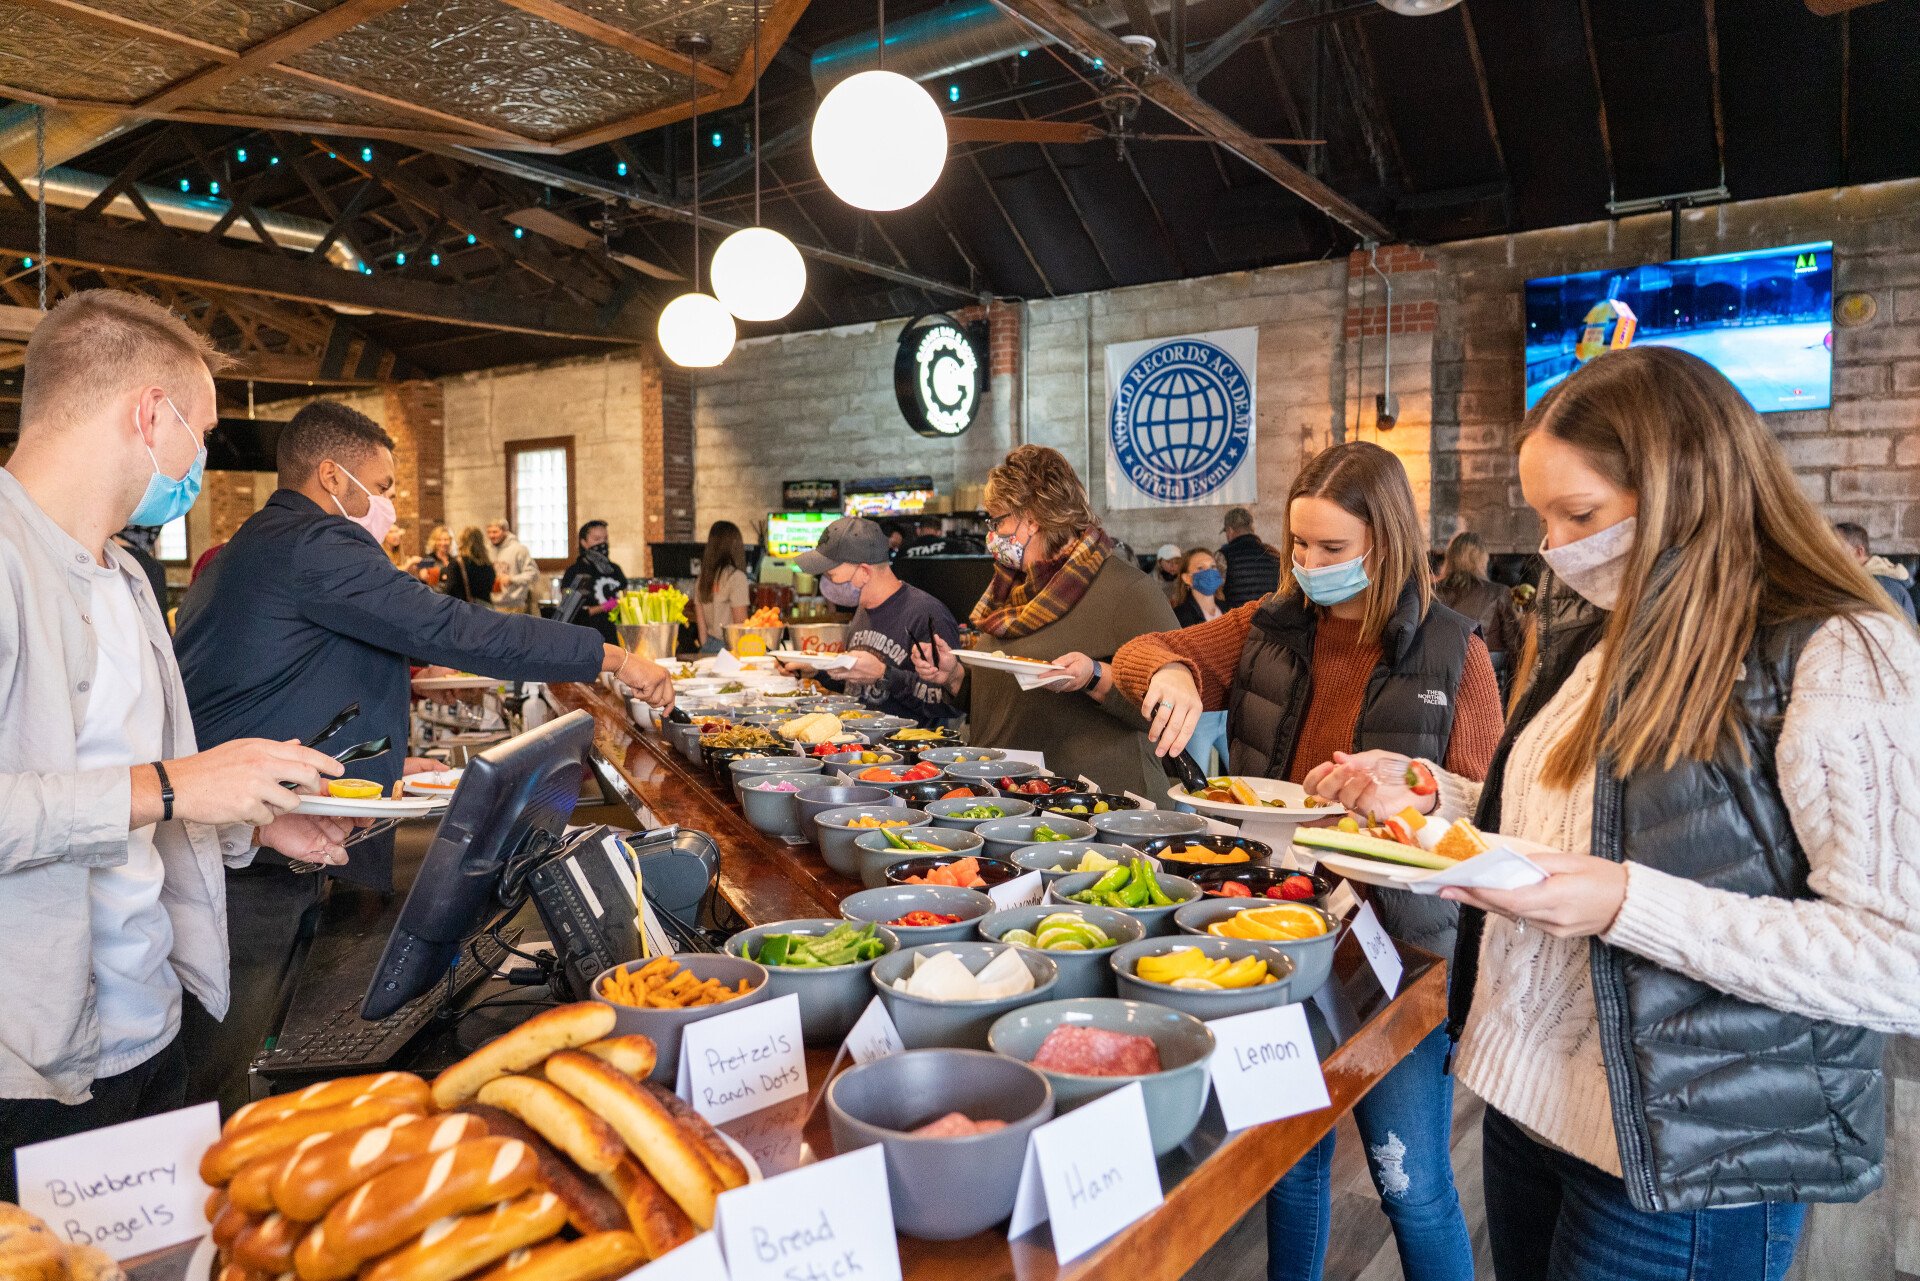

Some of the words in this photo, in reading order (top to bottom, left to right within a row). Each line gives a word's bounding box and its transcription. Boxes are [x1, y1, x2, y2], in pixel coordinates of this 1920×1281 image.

[1114, 383, 1135, 453] WORLD
[1130, 345, 1210, 384] RECORDS
[1208, 356, 1250, 444] ACADEMY
[1131, 465, 1185, 497] Official
[1190, 459, 1233, 492] Event
[907, 542, 946, 558] STAFF
[705, 1035, 792, 1076] Pretzels
[1233, 1041, 1300, 1072] Lemon
[703, 1079, 755, 1107] Ranch
[760, 1065, 800, 1091] Dots
[45, 1163, 176, 1208] Blueberry
[1063, 1161, 1124, 1210] Ham
[64, 1204, 175, 1246] Bagels
[751, 1208, 836, 1263] Bread
